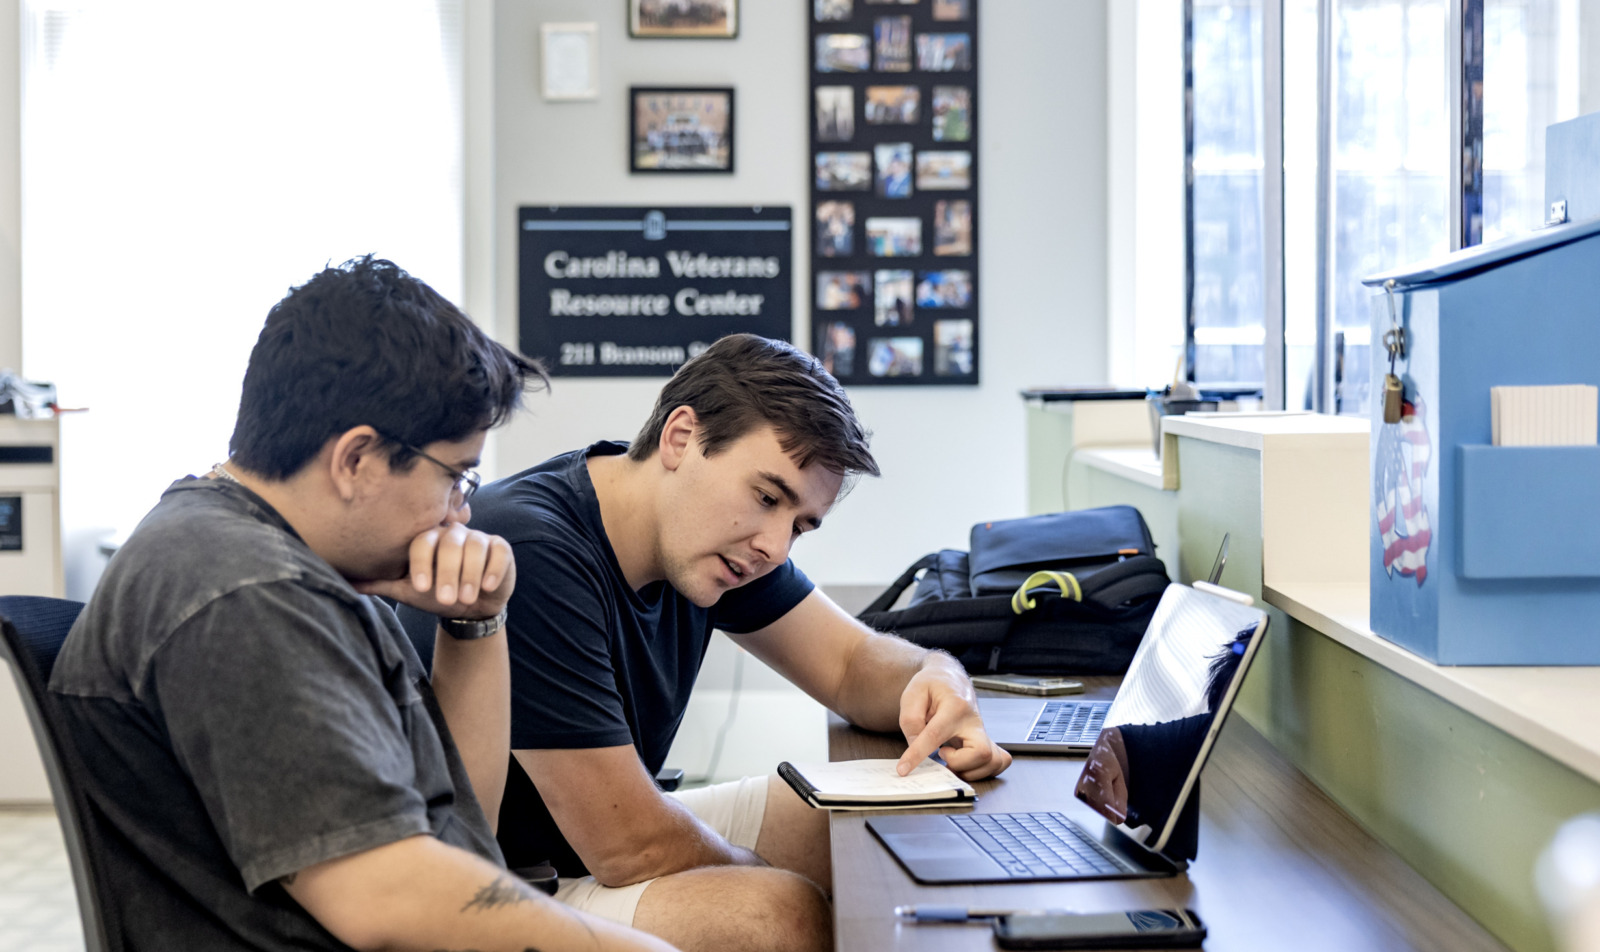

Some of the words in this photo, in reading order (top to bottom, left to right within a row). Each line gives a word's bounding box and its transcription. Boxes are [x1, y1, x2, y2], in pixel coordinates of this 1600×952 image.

[544, 250, 660, 279] Carolina
[666, 250, 780, 279] Veterans
[550, 288, 669, 316] Resource
[674, 288, 764, 316] Center
[560, 342, 595, 365] 211
[600, 342, 685, 365] Branson
